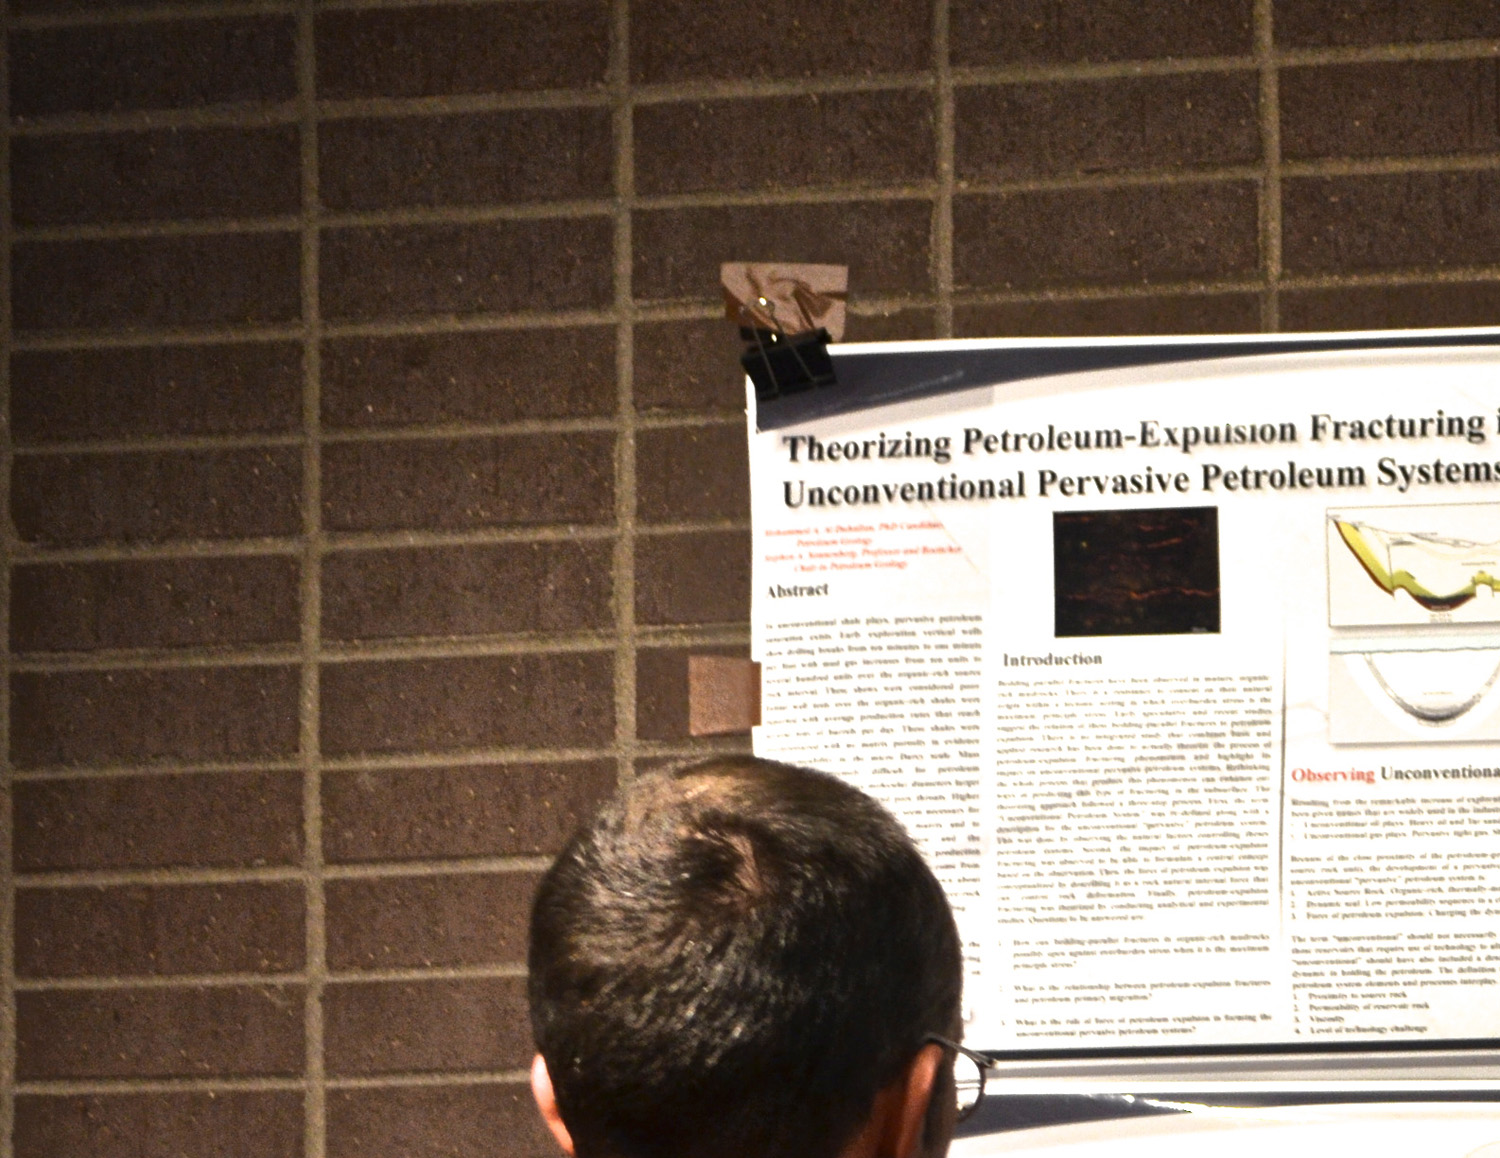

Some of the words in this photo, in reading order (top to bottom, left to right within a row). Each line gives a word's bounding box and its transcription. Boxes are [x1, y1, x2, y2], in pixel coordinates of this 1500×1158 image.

[782, 432, 950, 463] Theorizing
[964, 421, 1296, 454] Petroleum-Expulsion
[1311, 412, 1485, 443] Fracturing
[784, 473, 1025, 507] Unconventional
[1038, 467, 1188, 496] Pervasive
[1202, 463, 1365, 490] Petroleum
[768, 583, 828, 598] Abstract
[1003, 652, 1102, 666] Introduction
[1291, 768, 1375, 784] Observing
